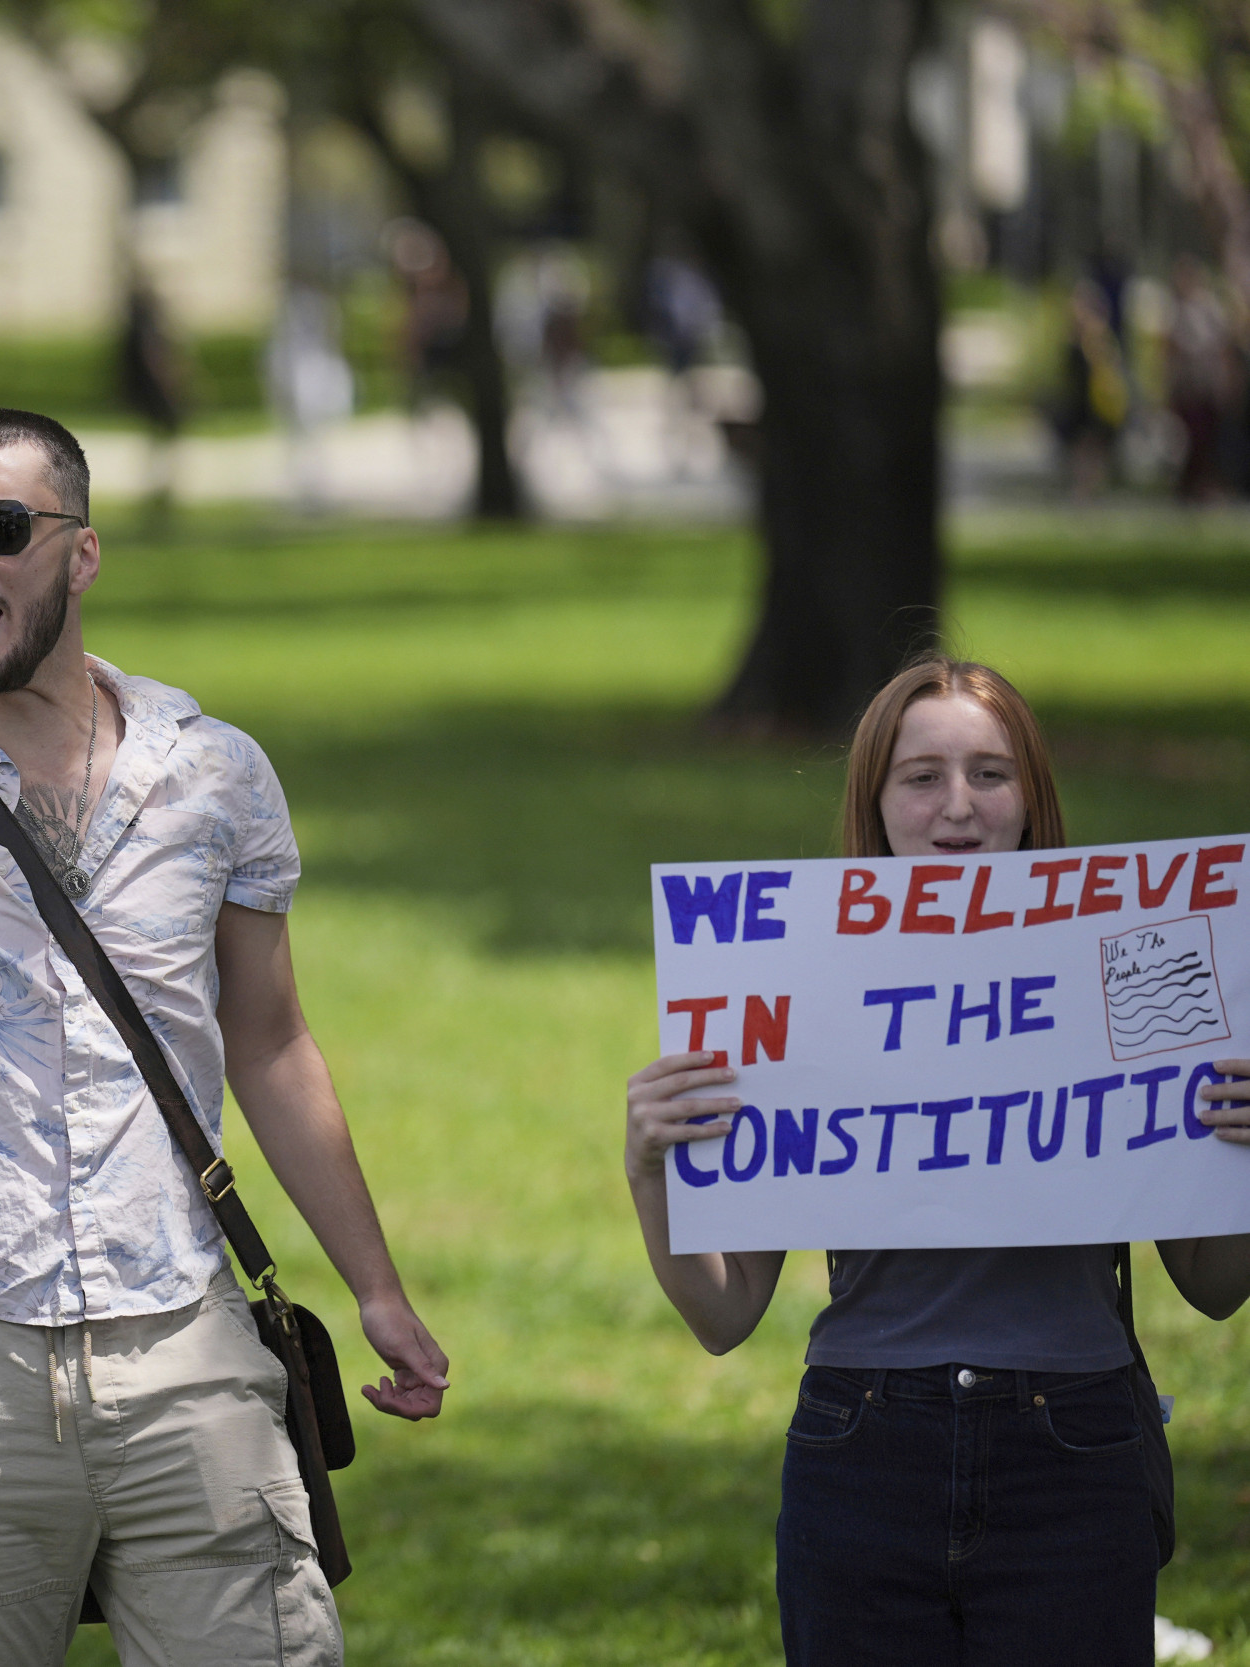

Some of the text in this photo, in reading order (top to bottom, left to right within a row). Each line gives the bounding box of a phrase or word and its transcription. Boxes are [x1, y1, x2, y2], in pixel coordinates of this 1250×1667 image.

[661, 843, 1246, 945] WE BELIEVE
[1101, 932, 1166, 964] We The
[1104, 960, 1142, 985] People
[667, 975, 1056, 1069] IN THE
[674, 1061, 1250, 1188] CONSTITUTIO
